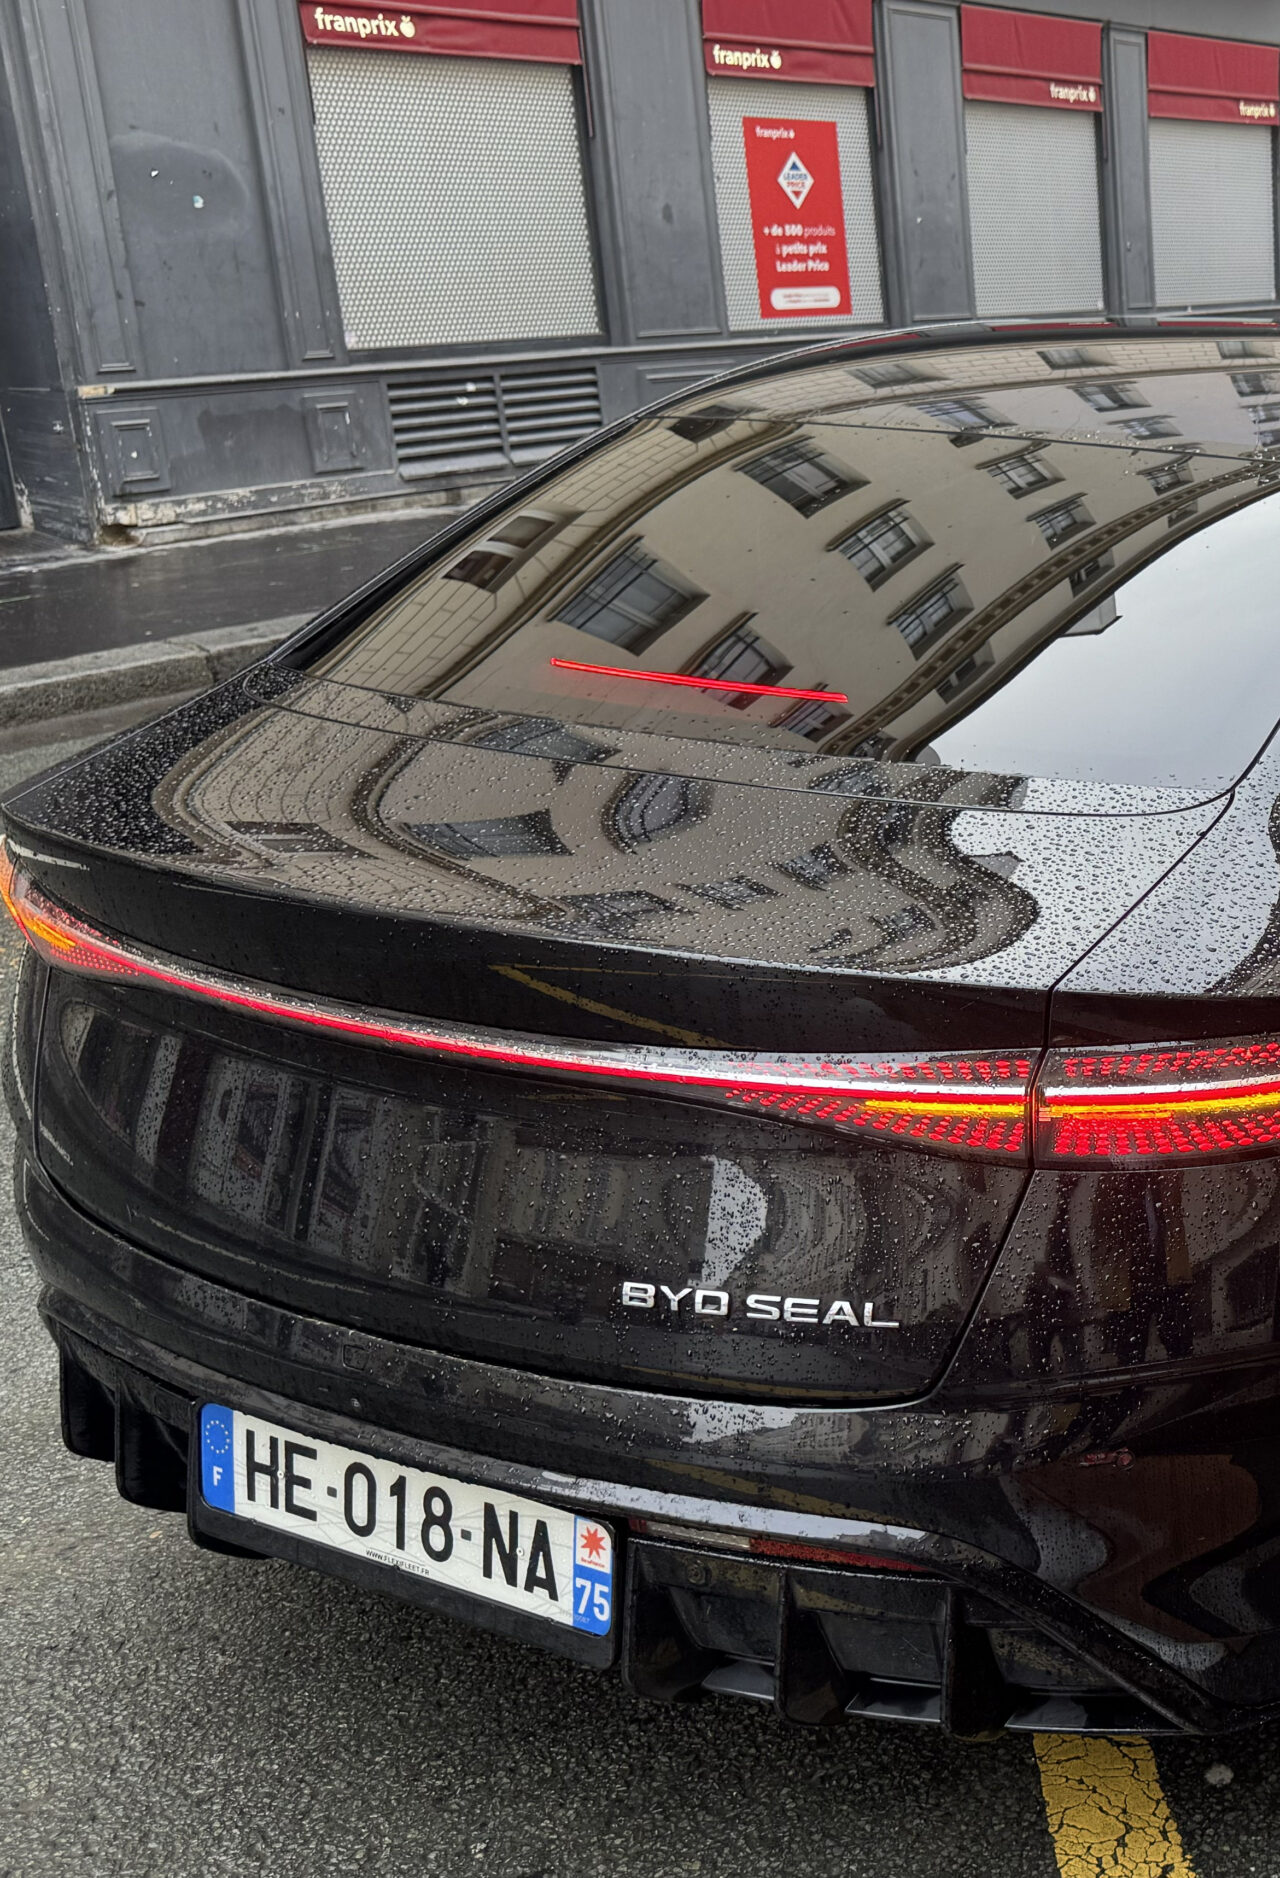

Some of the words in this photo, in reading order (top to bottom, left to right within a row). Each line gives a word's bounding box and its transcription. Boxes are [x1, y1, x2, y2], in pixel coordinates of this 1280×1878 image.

[314, 7, 399, 38] franprix
[713, 44, 770, 70] franprix
[1050, 83, 1088, 103] franprix
[1239, 100, 1270, 119] franprix
[755, 125, 789, 140] franprix
[770, 224, 783, 237] de
[804, 225, 836, 240] produits
[781, 241, 808, 258] petits
[808, 241, 828, 258] prix
[775, 260, 806, 273] Leader
[807, 259, 830, 273] Price
[622, 1281, 729, 1316] BYD
[746, 1294, 900, 1329] SEAL
[212, 1465, 224, 1487] F
[246, 1428, 559, 1603] HE-018-NA
[575, 1576, 611, 1622] 75
